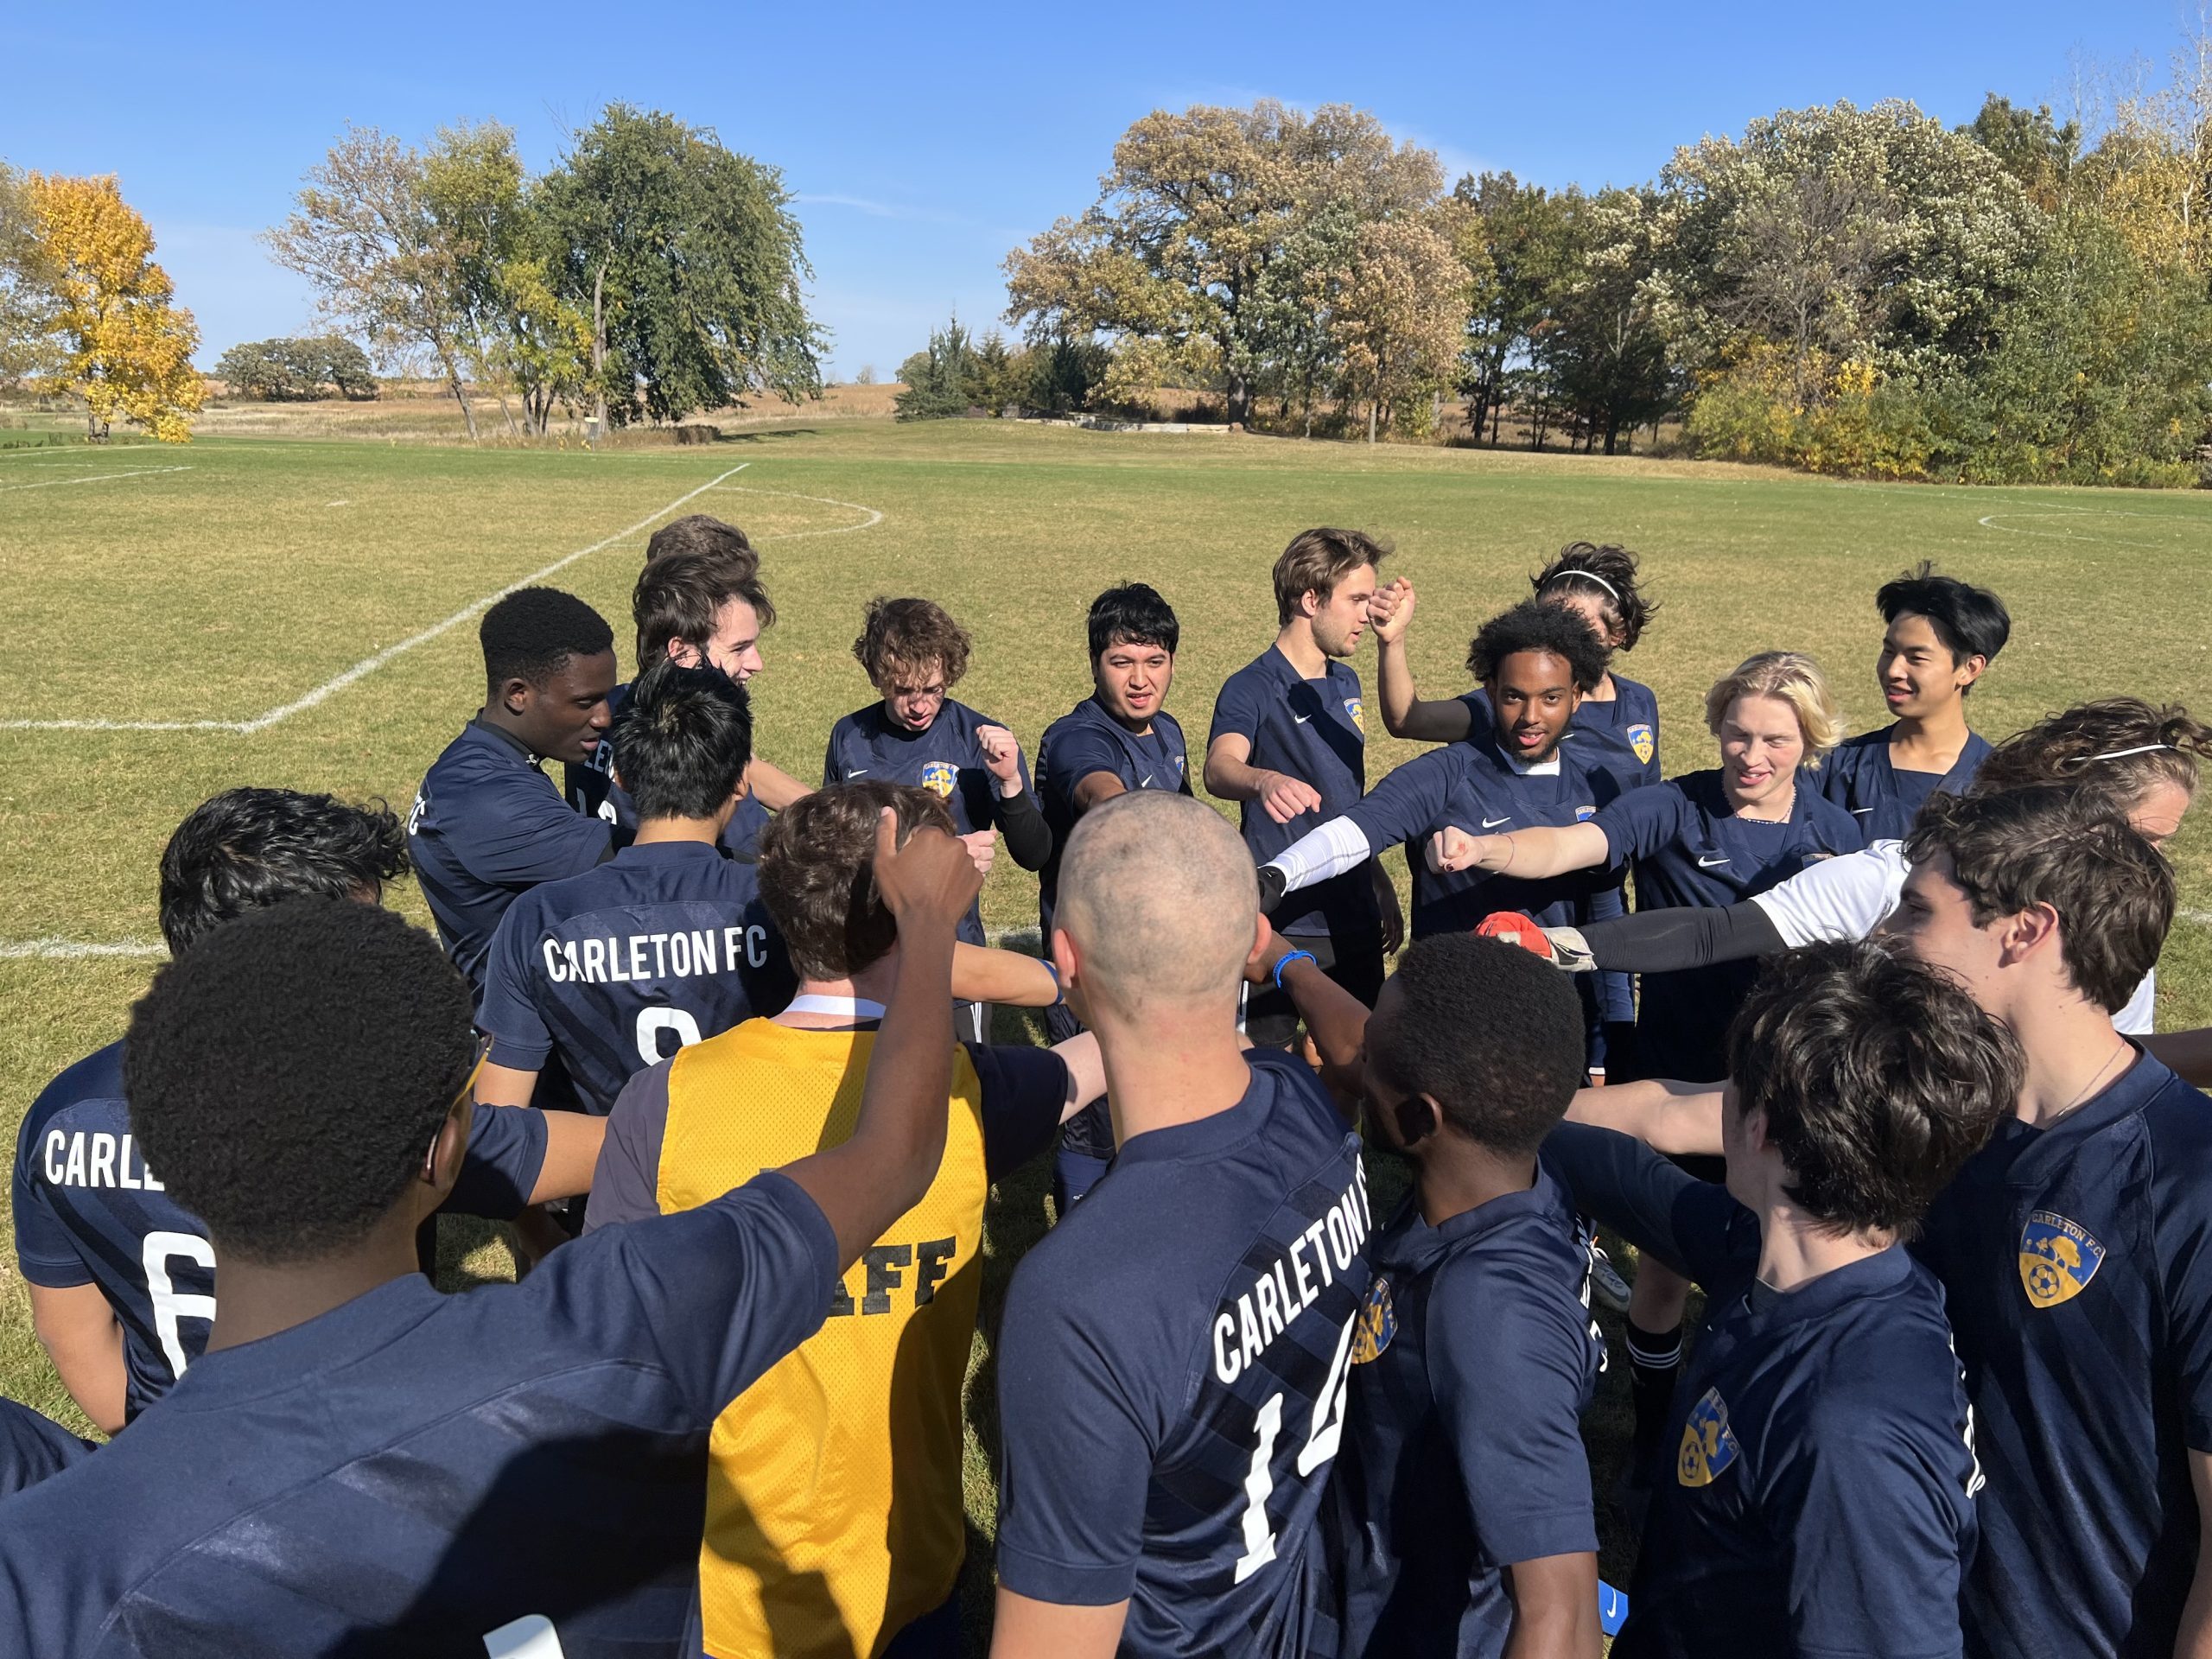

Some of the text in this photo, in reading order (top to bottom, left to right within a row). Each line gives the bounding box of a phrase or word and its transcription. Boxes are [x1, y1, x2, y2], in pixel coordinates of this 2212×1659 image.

[543, 925, 767, 983] CARLETON FC
[1214, 1183, 1365, 1384] CARLETON
[2031, 1212, 2086, 1242] CARLETON
[1235, 1308, 1357, 1585] 14
